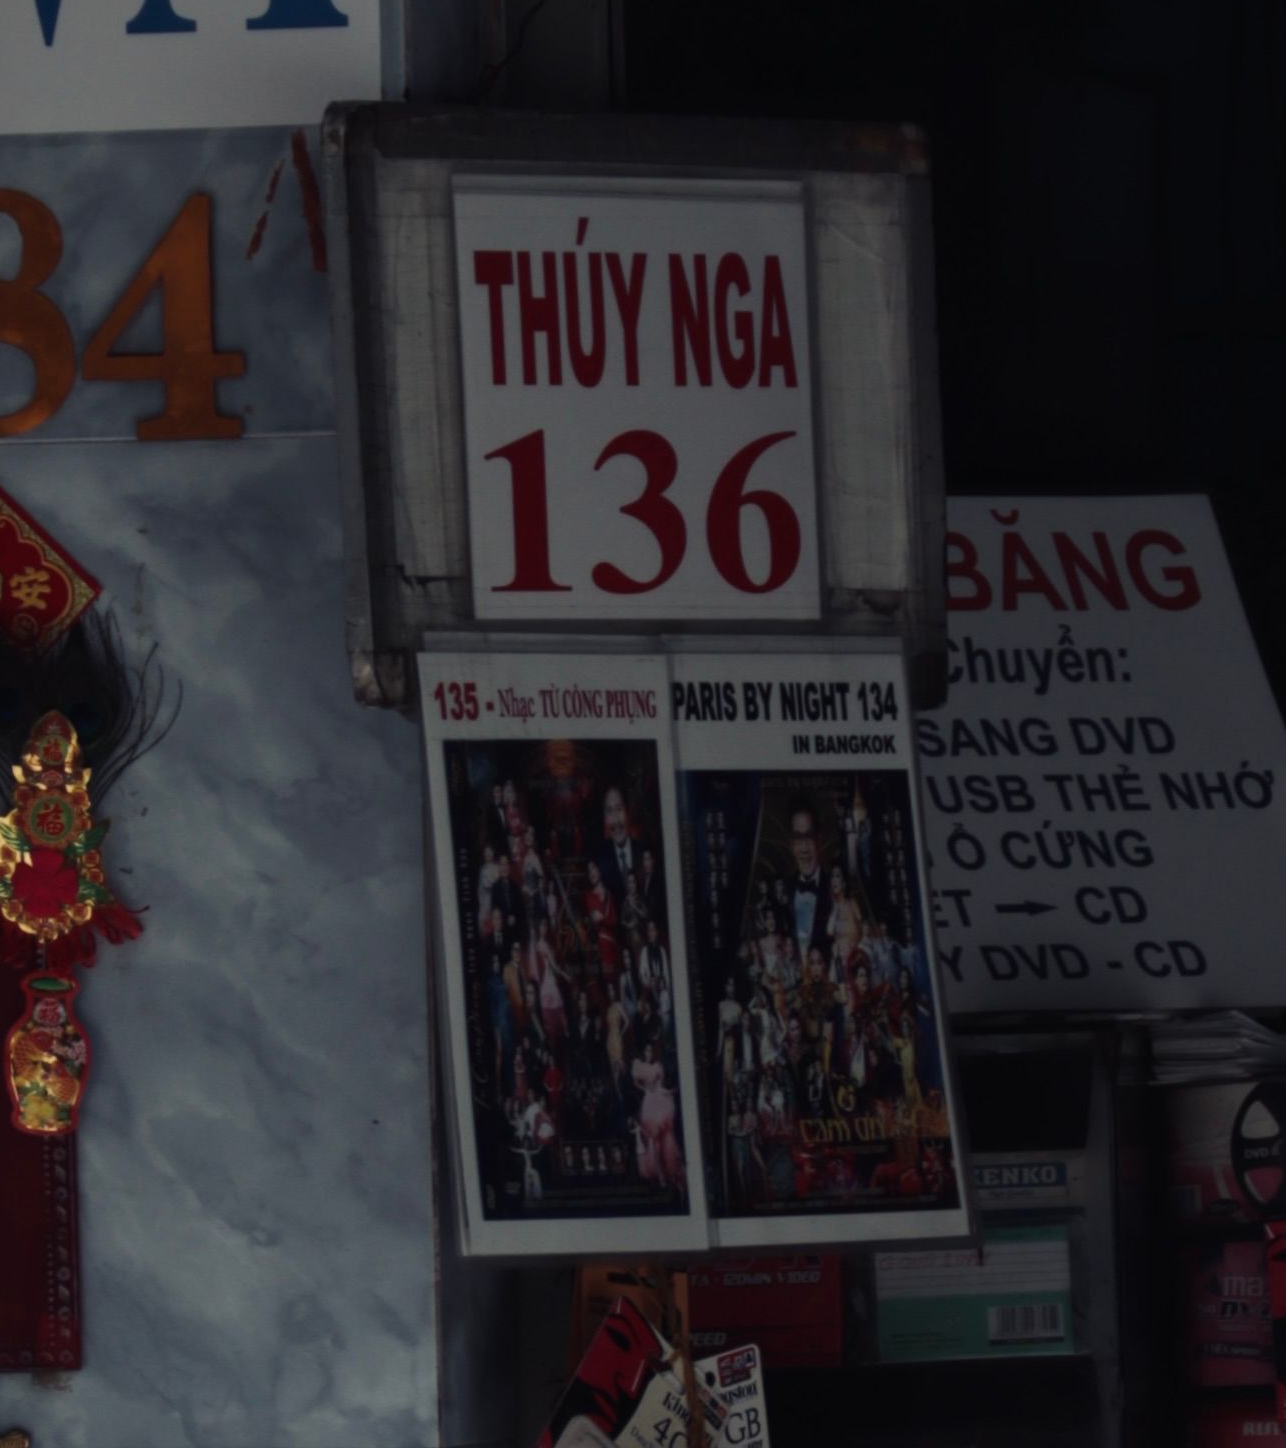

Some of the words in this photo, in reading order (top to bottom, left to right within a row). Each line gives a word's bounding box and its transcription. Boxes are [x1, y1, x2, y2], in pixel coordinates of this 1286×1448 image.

[473, 218, 648, 388] THÚY
[671, 251, 799, 390] NGA
[482, 428, 802, 595] 136
[10, 566, 53, 611] 安
[434, 681, 480, 722] 135
[560, 683, 604, 719] CÔNG
[606, 688, 658, 726] PHỤNG
[673, 680, 740, 722] PARIS
[743, 680, 773, 722] BY
[779, 680, 850, 722] NIGHT
[857, 680, 898, 722] 134
[791, 735, 811, 754] IN
[814, 735, 897, 754] BANGKOK
[1067, 716, 1177, 755] DVD
[926, 773, 1037, 814] USB
[1042, 764, 1153, 813] THẺ
[1158, 760, 1277, 812] NHỚ
[946, 821, 987, 872] Ổ
[999, 819, 1156, 871] CỨNG
[1074, 886, 1149, 925] CD
[979, 944, 1090, 982] DVD
[1133, 940, 1208, 978] CD
[776, 1269, 822, 1286] VIDEO
